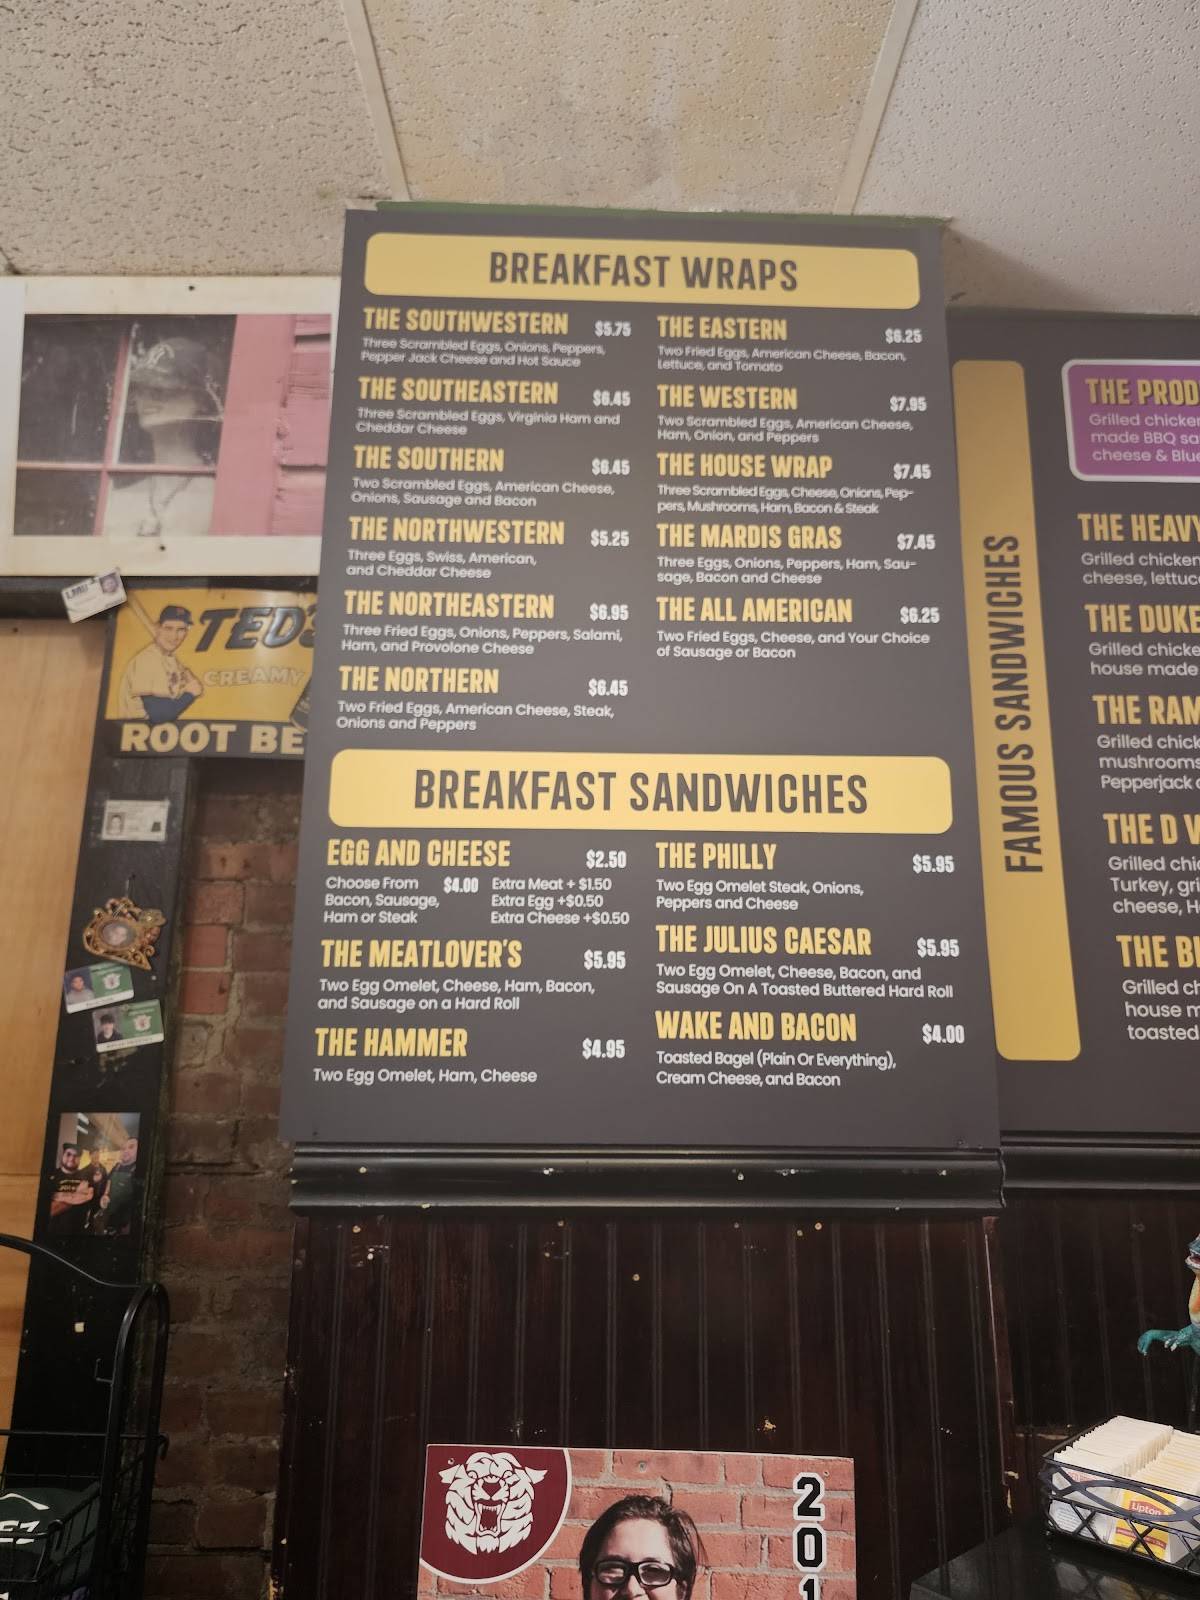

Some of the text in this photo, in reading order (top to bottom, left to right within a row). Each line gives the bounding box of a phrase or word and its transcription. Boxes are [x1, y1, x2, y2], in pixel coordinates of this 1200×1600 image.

[490, 252, 798, 291] BREAKFAST WRAPS
[364, 307, 569, 334] THE SOUTHWESTERN
[595, 321, 632, 336] $5.75
[658, 315, 787, 340] THE EASTERN
[886, 329, 923, 343] $6.25
[364, 338, 606, 356] Three Scrambled Eggs, Onions, Peppers,
[359, 377, 558, 403] THE SOUTHEASTERN
[594, 390, 631, 406] $6.45
[658, 384, 798, 409] THE WESTERN
[1086, 378, 1200, 405] THE PROD
[890, 397, 927, 412] $7.95
[356, 422, 468, 435] Cheddar Cheese
[658, 430, 820, 445] Ham, Onion, and Peppers
[1092, 432, 1177, 446] made BBQ
[354, 445, 504, 471] THE SOUTHERN
[592, 459, 630, 475] $6.45
[657, 452, 833, 478] THE HOUSE WRAP
[894, 464, 932, 480] $7.45
[350, 516, 565, 544] THE NORTHWESTERN
[656, 523, 842, 549] THE MARDIS GRAS
[1078, 513, 1124, 541] THE
[591, 530, 630, 546] $5.25
[898, 534, 936, 550] $7.45
[348, 550, 537, 565] Three Eggs, Swiss, American,
[1082, 553, 1135, 566] Grilled
[346, 565, 492, 578] and Cheddar Cheese
[657, 572, 822, 585] sage, Bacon and Cheese
[345, 590, 554, 618] THE NORTHEASTERN
[590, 604, 629, 620] $6.95
[656, 596, 853, 622] THE ALL AMERICAN
[900, 607, 940, 624] $6.25
[1085, 604, 1133, 632] THE
[203, 665, 305, 688] CREAMY
[1091, 662, 1199, 676] house made
[340, 665, 499, 693] THE NORTHERN
[589, 679, 629, 696] $6.45
[983, 535, 1044, 873] FAMOUS SANDWICHES
[1093, 695, 1142, 724] THE
[336, 717, 477, 733] Onions and Peppers
[120, 722, 237, 753] ROOT
[1097, 735, 1153, 748] Grilled
[415, 769, 868, 813] BREAKFAST SANDWICHES
[1101, 775, 1193, 793] Pepperjack
[1103, 813, 1154, 844] THE
[1160, 814, 1178, 844] D
[328, 839, 511, 866] EGG AND CHEESE
[586, 850, 627, 868] $2.50
[656, 842, 777, 869] THE PHILLY
[913, 855, 955, 873] $5.95
[326, 877, 419, 889] Choose From
[444, 877, 479, 893] $4.00
[656, 879, 864, 895] Two Egg Omelet Steak, Onions,
[1110, 878, 1174, 896] Turkey,
[326, 894, 440, 910] Bacon, Sausage,
[657, 896, 799, 912] Peppers and Cheese
[324, 911, 418, 923] Ham or Steak
[656, 924, 872, 955] THE JULIUS CAESAR
[917, 938, 960, 957] $5.95
[322, 939, 522, 967] THE MEATLOVER'S
[584, 950, 626, 969] $5.95
[1116, 935, 1169, 967] THE
[320, 979, 596, 995] Two Egg Omelet, Cheese, Ham, Bacon,
[655, 1010, 857, 1041] WAKE AND BACON
[922, 1024, 965, 1044] $4.00
[1128, 1026, 1200, 1040] toasted
[316, 1027, 468, 1056] THE HAMMER
[583, 1039, 626, 1059] $4.95
[656, 1050, 897, 1070] Toasted Bagel (Plain Or Everything),
[314, 1069, 538, 1086] Two Egg Omelet, Ham, Cheese
[1131, 1501, 1162, 1516] Lipton
